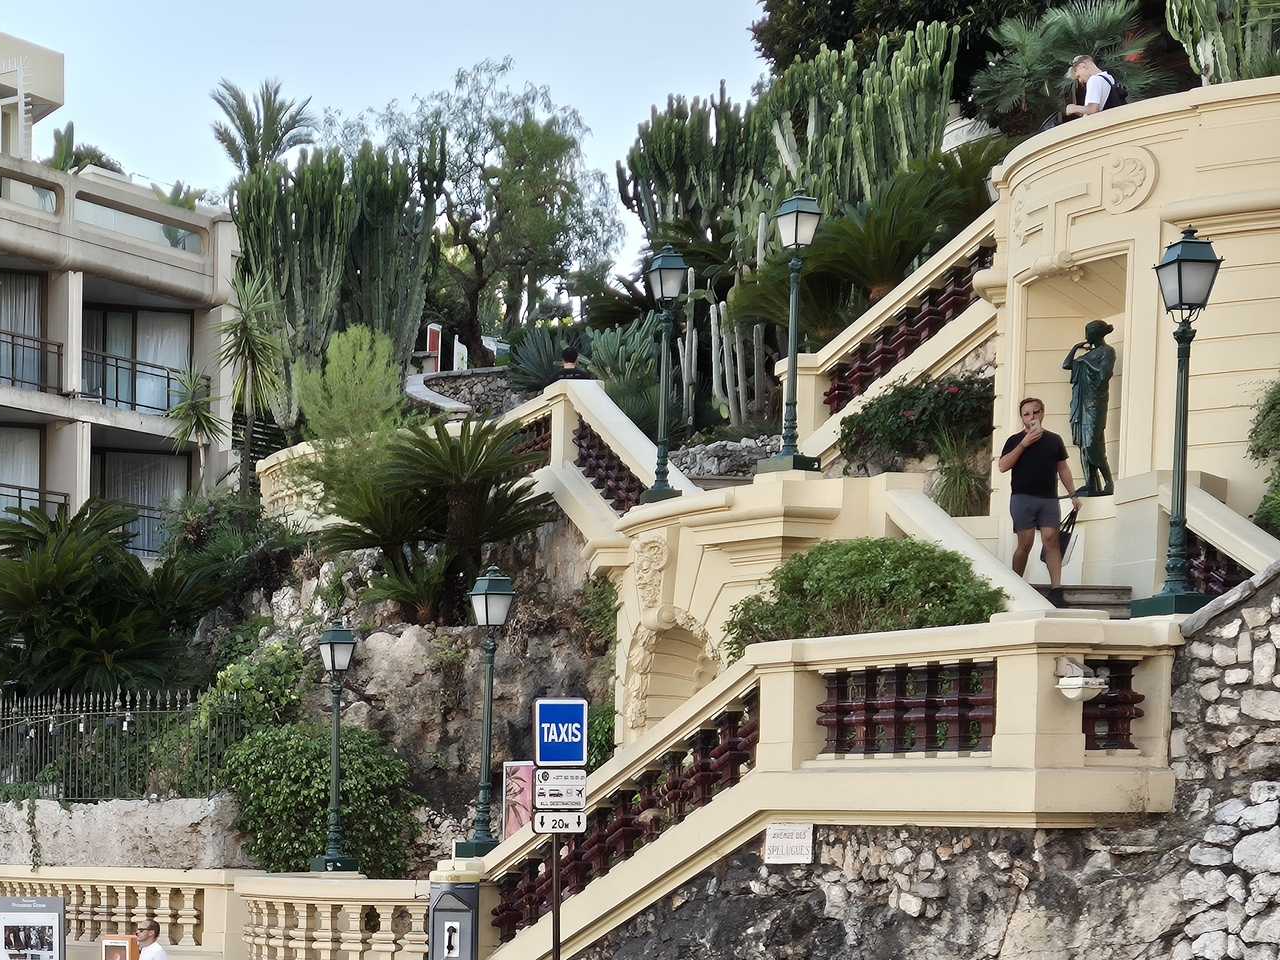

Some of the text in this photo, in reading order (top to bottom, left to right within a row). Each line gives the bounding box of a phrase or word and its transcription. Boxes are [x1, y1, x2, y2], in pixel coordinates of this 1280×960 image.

[541, 722, 581, 743] TAXIS
[772, 831, 807, 839] AVENUE DES
[767, 845, 810, 856] SPELUGUES
